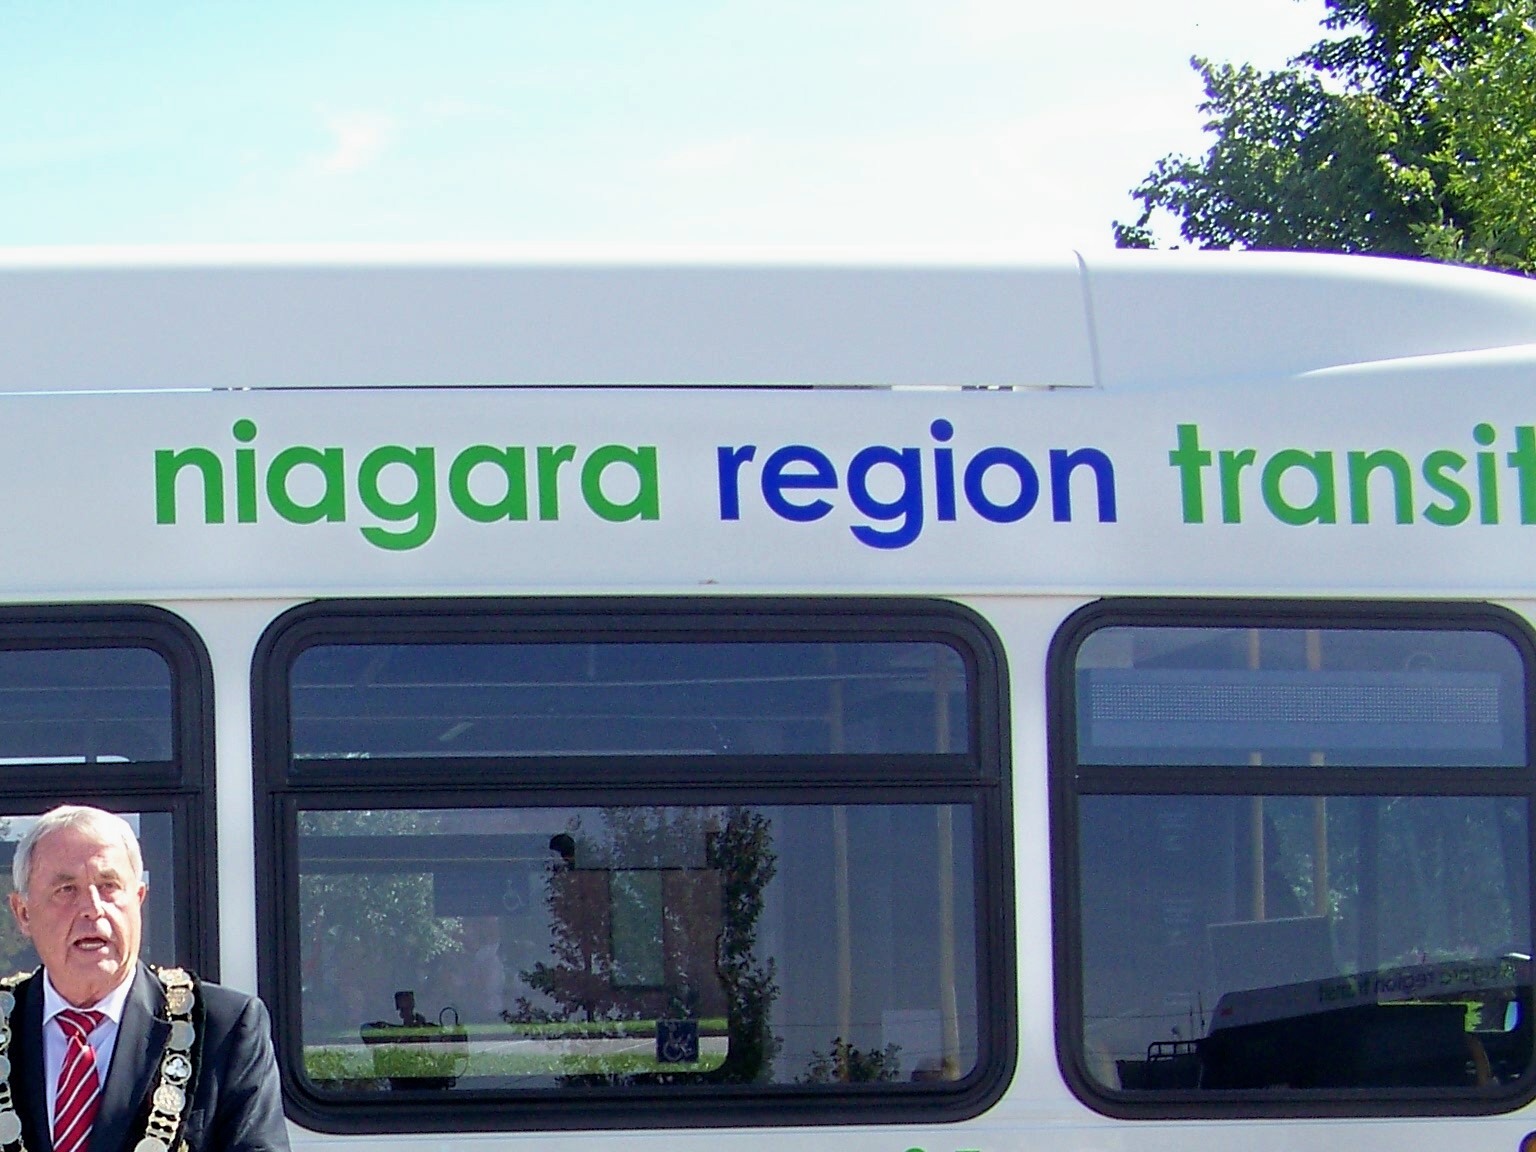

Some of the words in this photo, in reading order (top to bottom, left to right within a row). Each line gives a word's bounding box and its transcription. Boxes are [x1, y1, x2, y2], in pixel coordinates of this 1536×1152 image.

[154, 418, 660, 551] niagara
[717, 418, 1117, 551] region
[1169, 422, 1536, 526] transit
